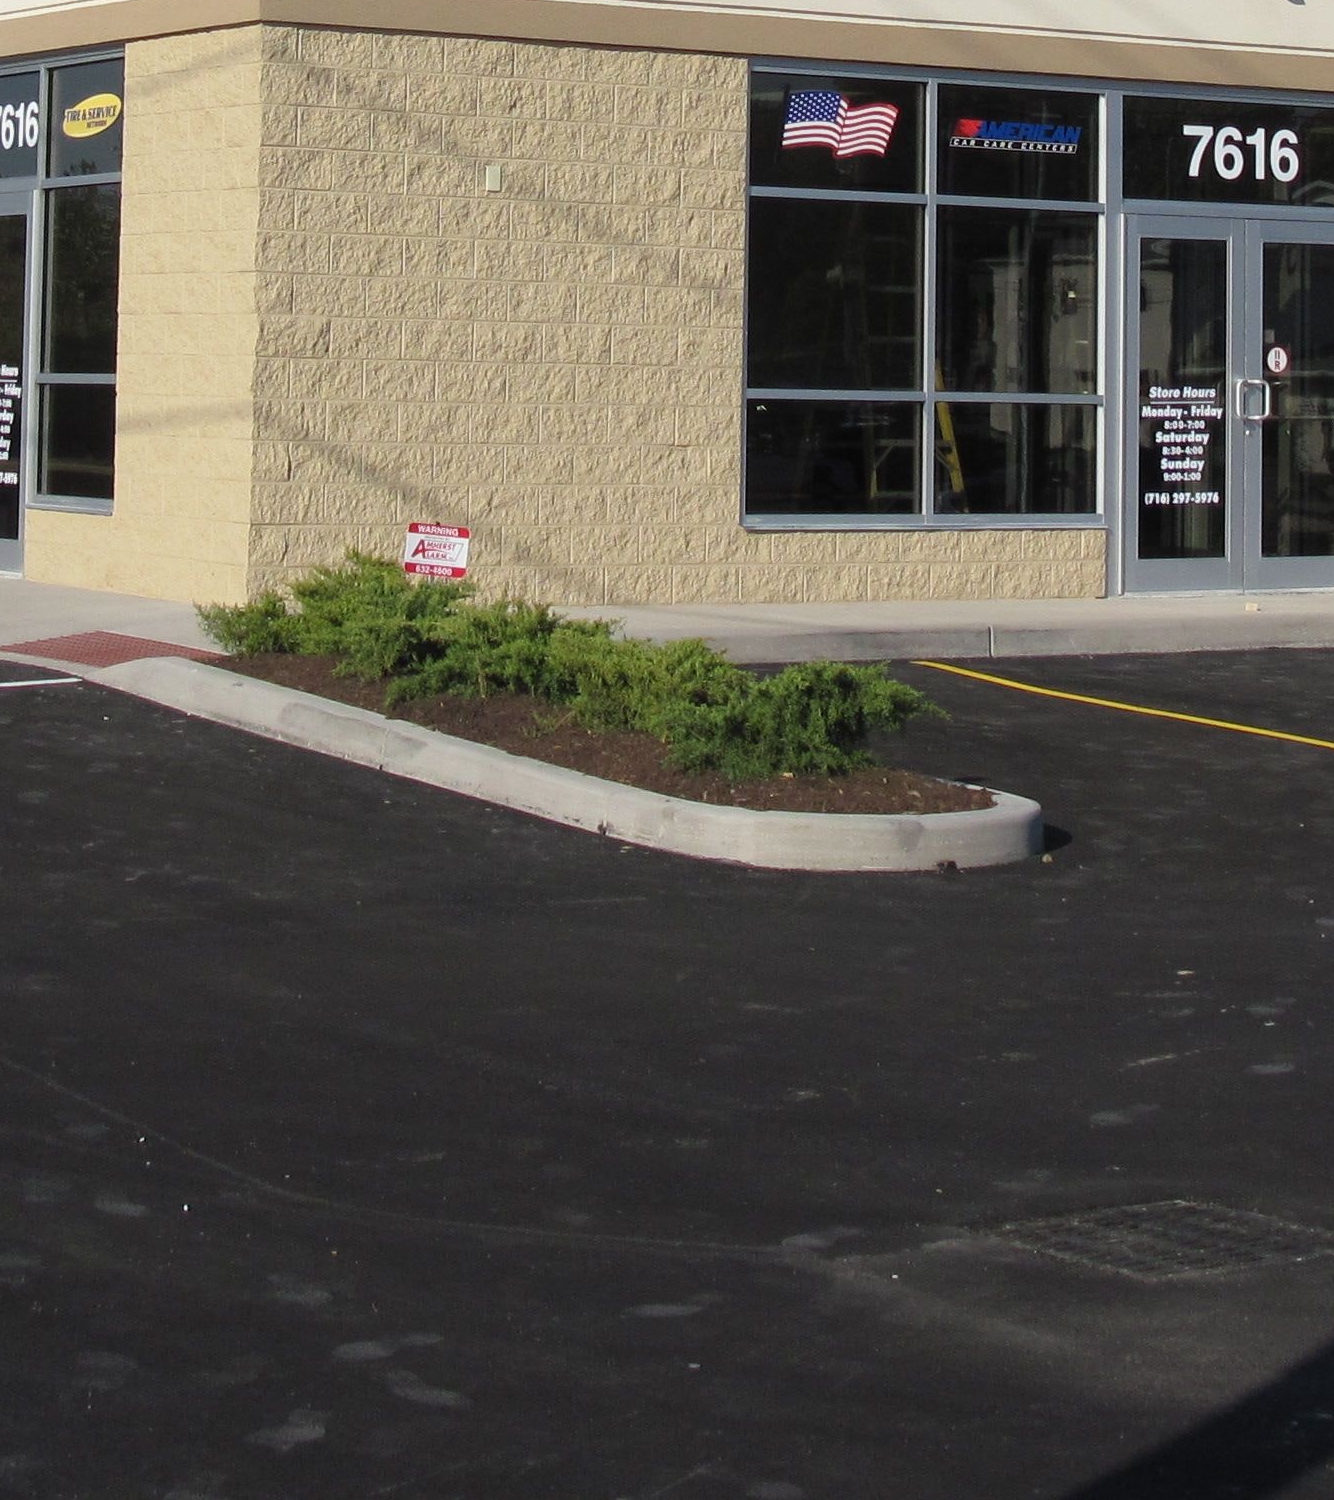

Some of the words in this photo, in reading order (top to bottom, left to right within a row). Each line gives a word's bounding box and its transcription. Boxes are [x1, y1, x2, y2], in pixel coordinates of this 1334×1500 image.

[978, 119, 1082, 143] AMERICAN
[953, 138, 975, 146] CAR
[983, 140, 1013, 149] CARE
[1020, 143, 1074, 152] CENTERS
[1183, 125, 1299, 182] 7616
[1149, 386, 1180, 398] Store
[1182, 386, 1216, 398] Hours
[1190, 405, 1223, 419] Friday
[1155, 431, 1209, 445] Saturday
[1160, 457, 1205, 471] Sunday
[1144, 492, 1170, 505] (716)
[1172, 491, 1219, 504] 297-5976
[417, 524, 459, 537] WARNING
